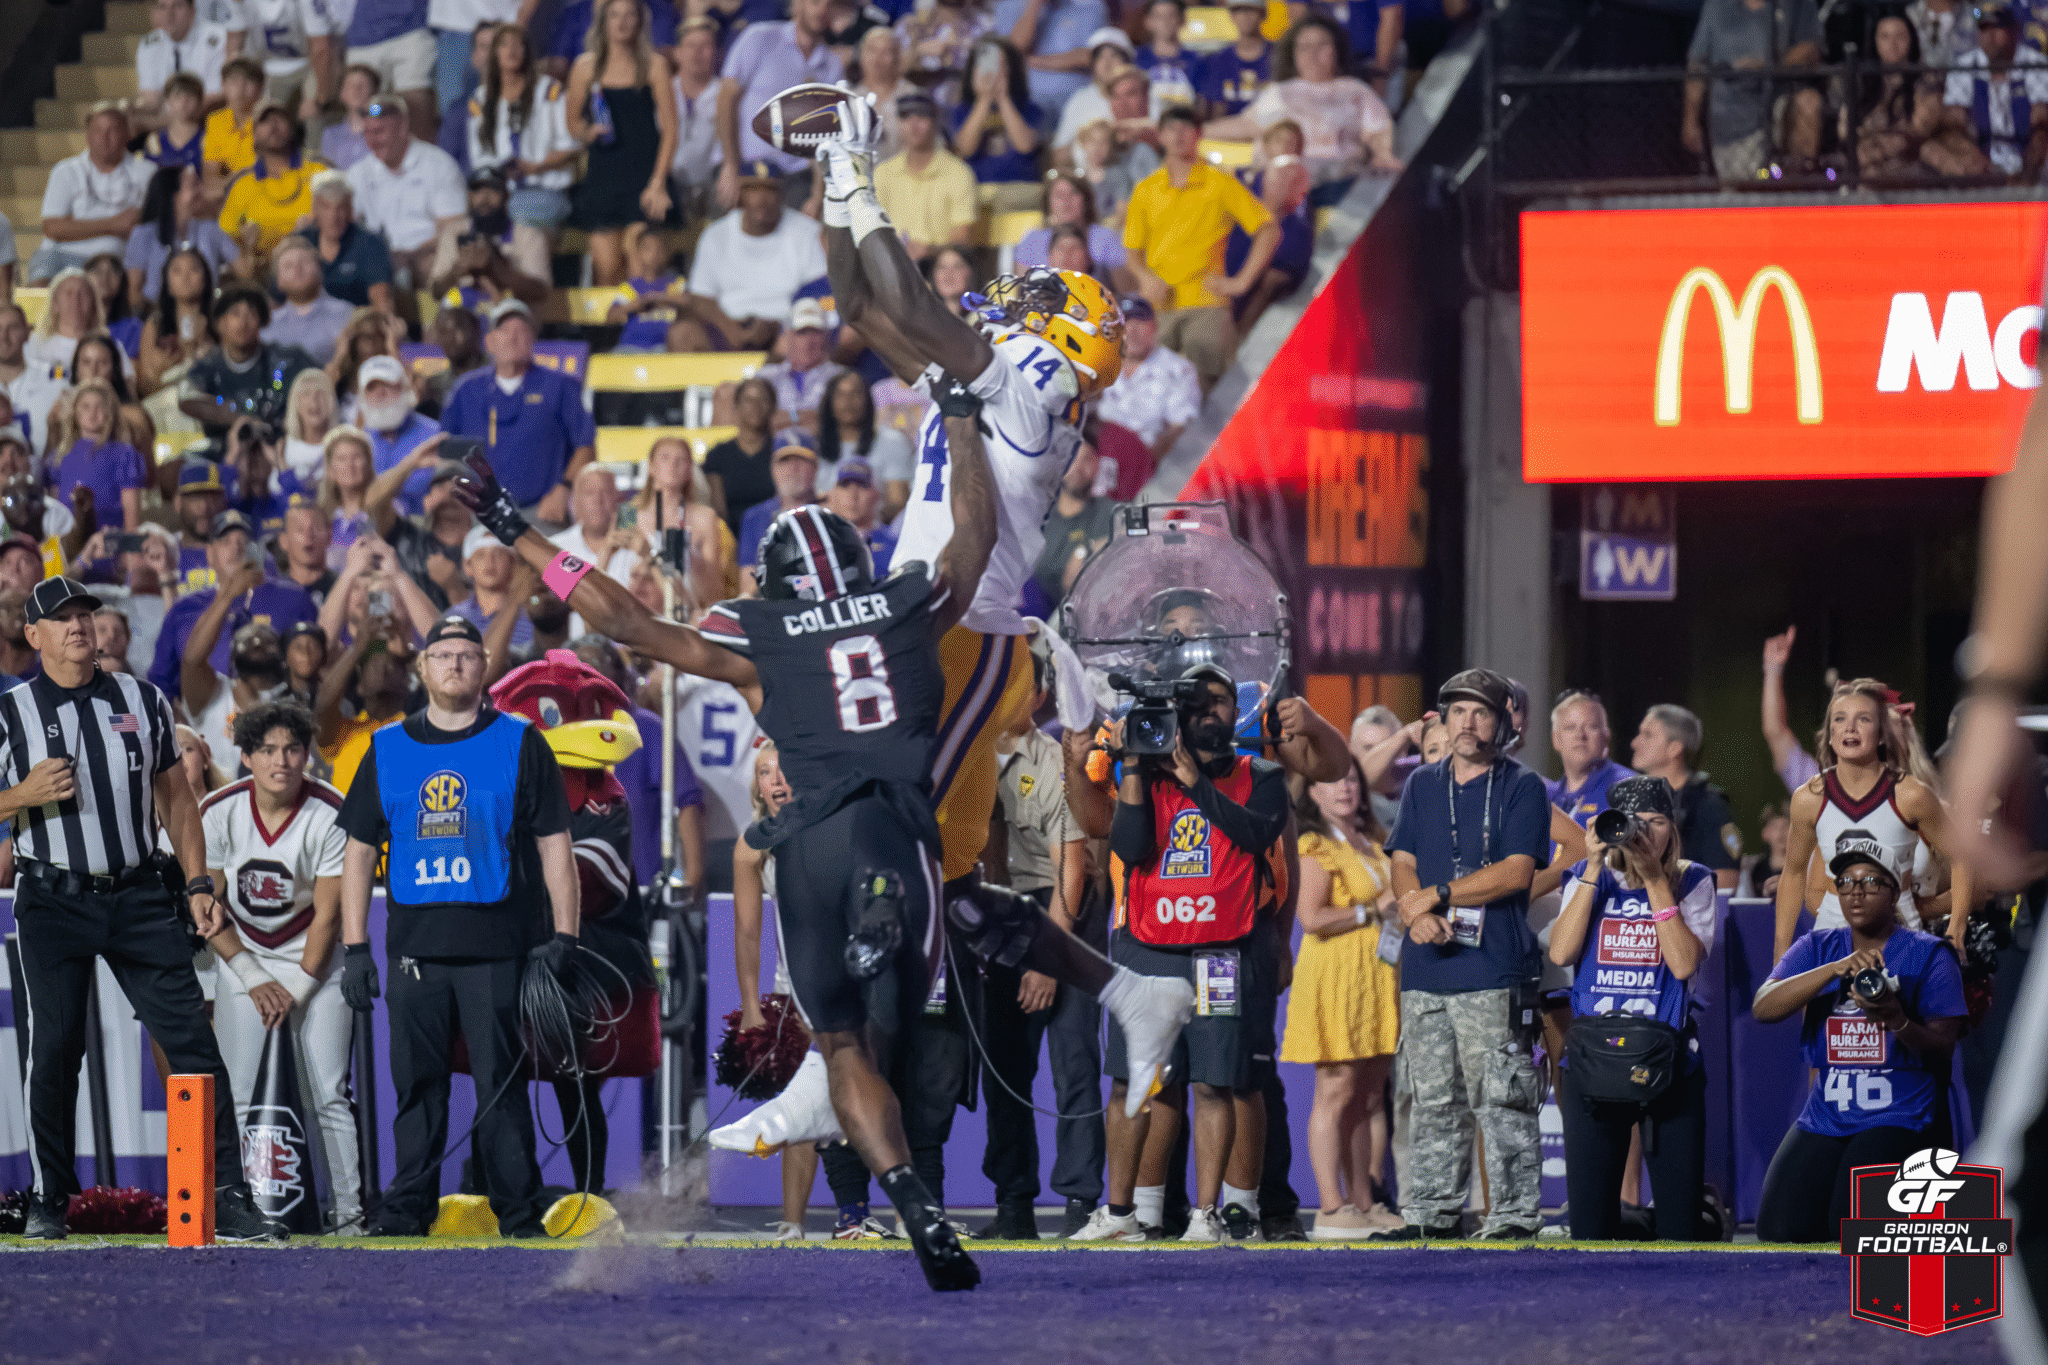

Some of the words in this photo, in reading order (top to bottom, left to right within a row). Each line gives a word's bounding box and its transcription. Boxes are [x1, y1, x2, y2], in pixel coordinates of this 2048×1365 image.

[1017, 346, 1062, 391] 14
[1616, 545, 1667, 586] W
[783, 593, 892, 636] COLLIER
[826, 634, 898, 733] 8
[47, 723, 59, 738] S
[701, 703, 737, 767] 5
[128, 751, 142, 771] L
[425, 774, 461, 812] SEC
[1174, 814, 1205, 851] SEC
[1169, 850, 1204, 862] ESPN
[415, 856, 471, 885] 110
[1166, 862, 1204, 875] NETWORK
[1156, 895, 1216, 924] 062
[1620, 923, 1657, 936] FARM
[1604, 934, 1657, 948] BUREAU
[1612, 951, 1656, 959] INSURANCE
[1596, 969, 1655, 987] MEDIA
[1841, 1022, 1879, 1034] FARM
[1830, 1034, 1879, 1047] BUREAU
[1837, 1050, 1879, 1058] INSURANCE
[1824, 1072, 1893, 1112] 46
